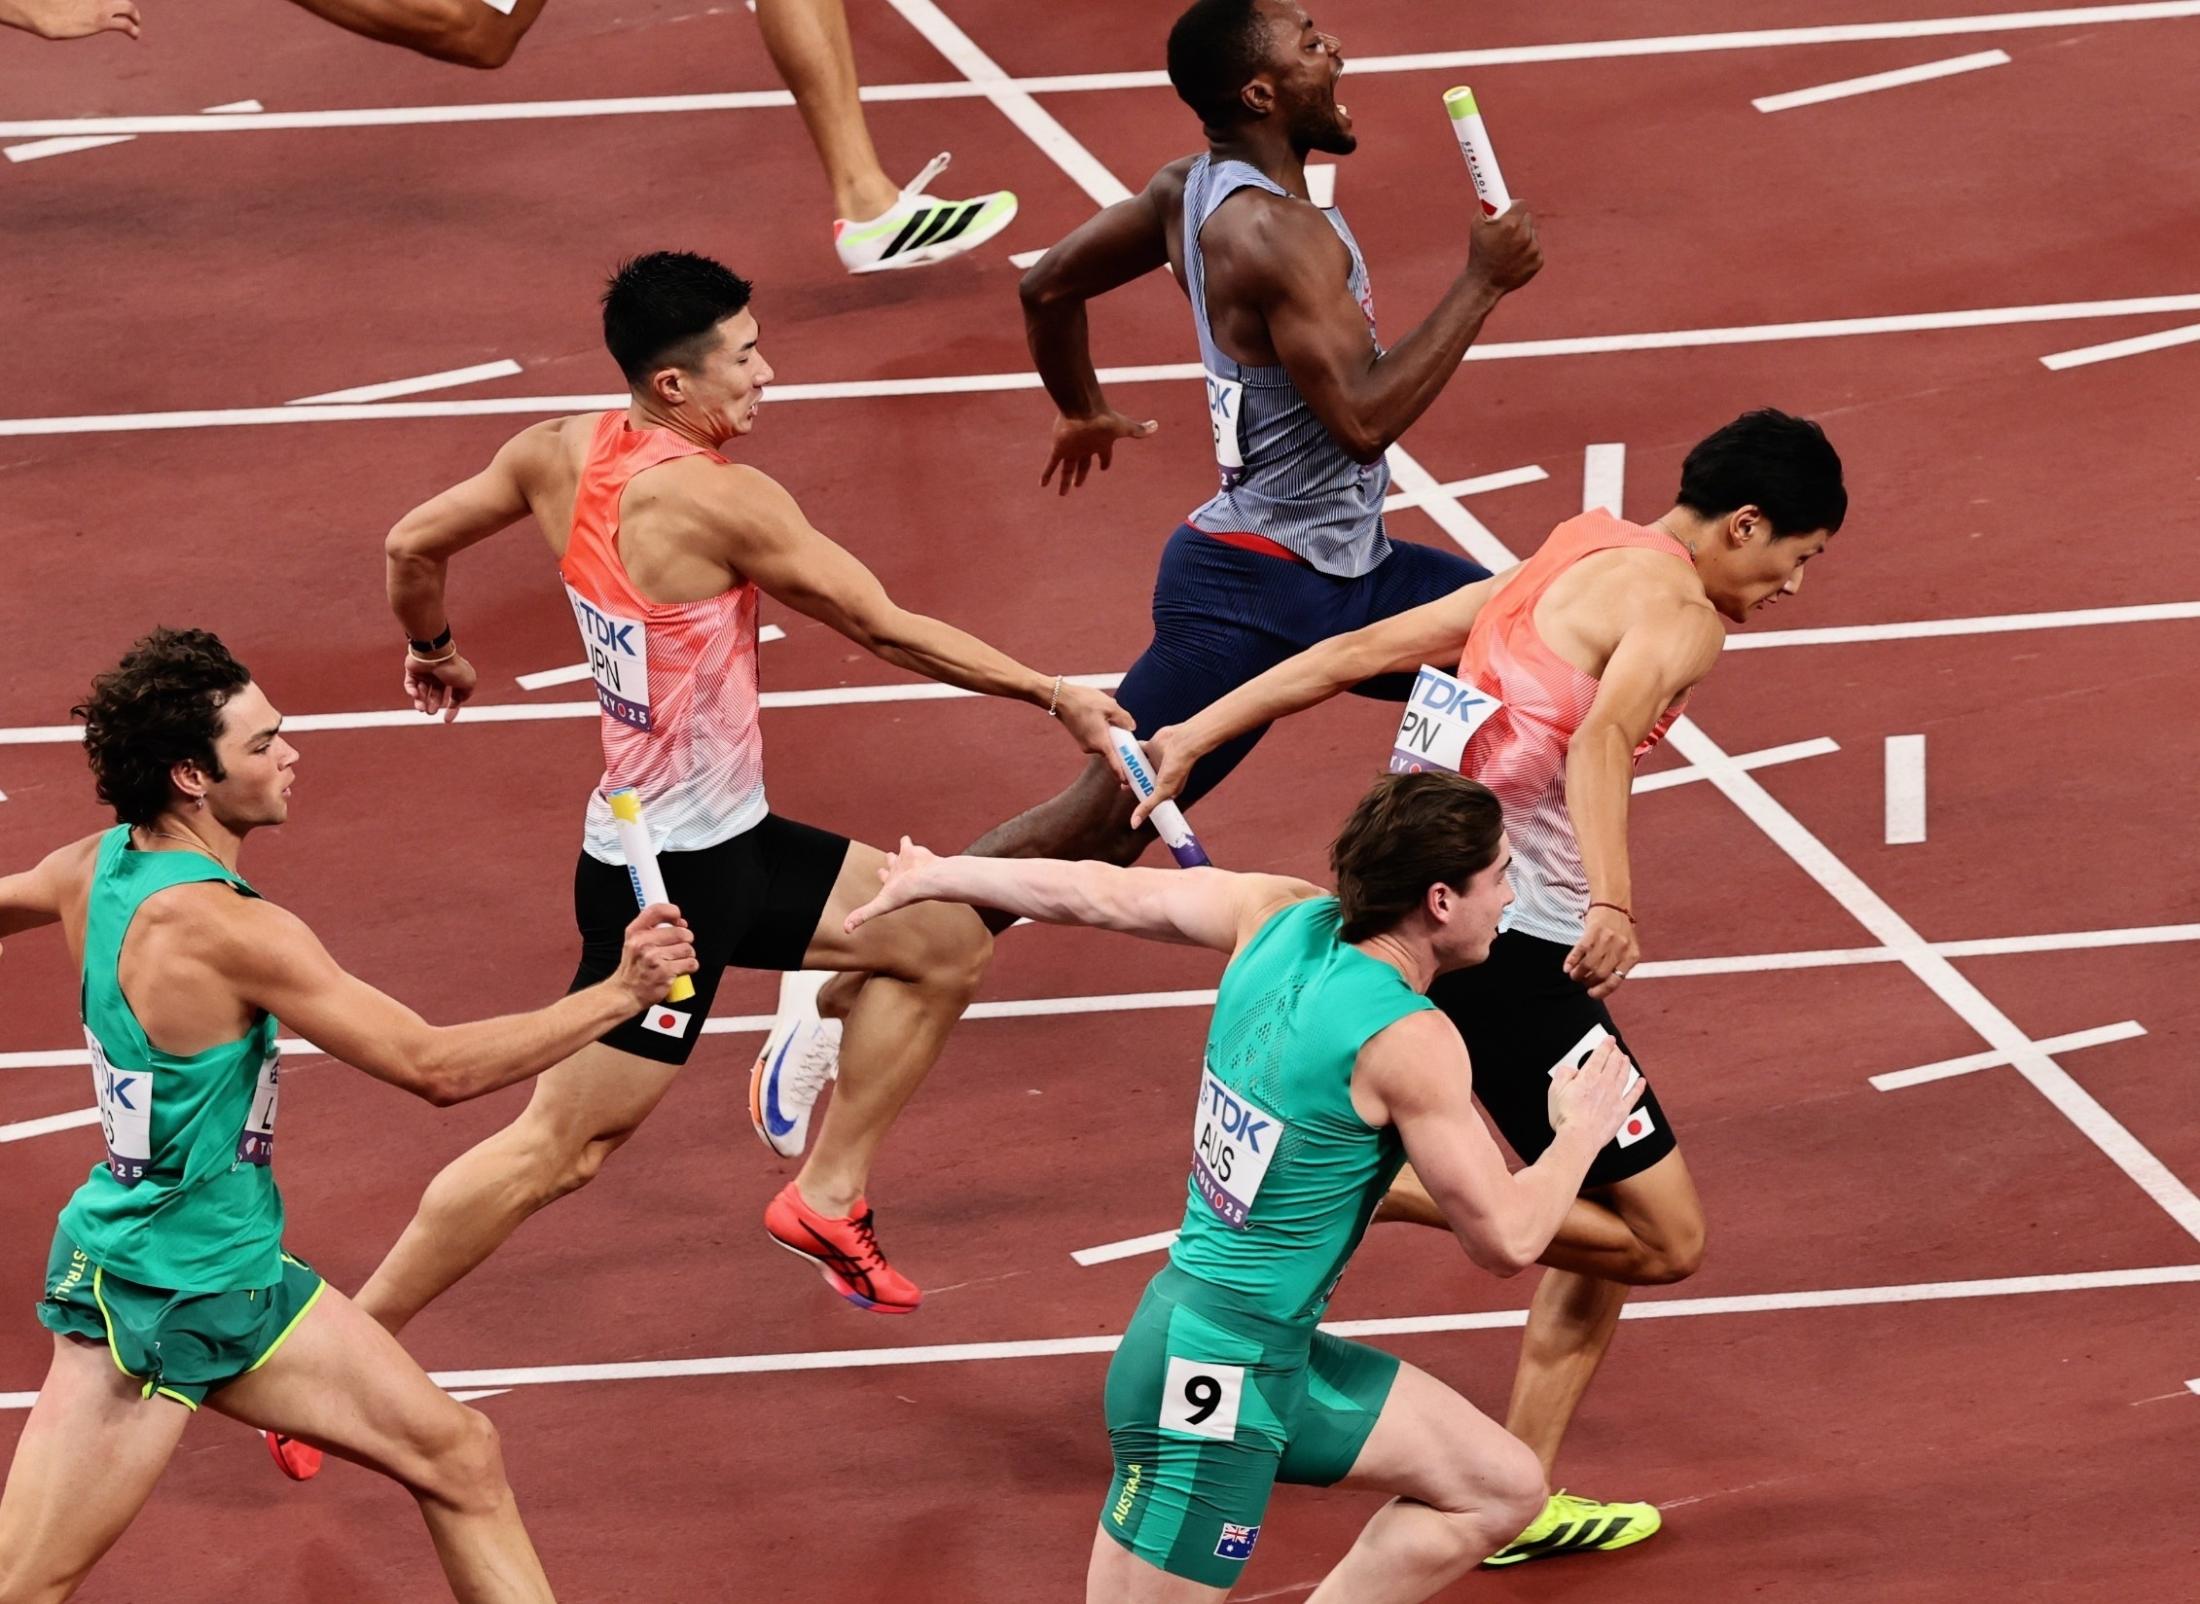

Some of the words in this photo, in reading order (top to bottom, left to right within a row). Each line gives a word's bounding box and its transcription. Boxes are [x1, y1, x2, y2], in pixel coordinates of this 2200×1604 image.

[1206, 377, 1232, 418] DK
[580, 602, 636, 656] TDK
[590, 643, 621, 692] JPN
[597, 687, 647, 725] KYO25
[1411, 670, 1488, 723] TDK
[1400, 711, 1442, 753] PN
[1123, 753, 1155, 797] MOND
[1209, 1080, 1270, 1153] TDK
[1200, 1122, 1234, 1182] AUS
[1184, 1375, 1222, 1425] 9
[1112, 1464, 1142, 1526] AUSTRAA
